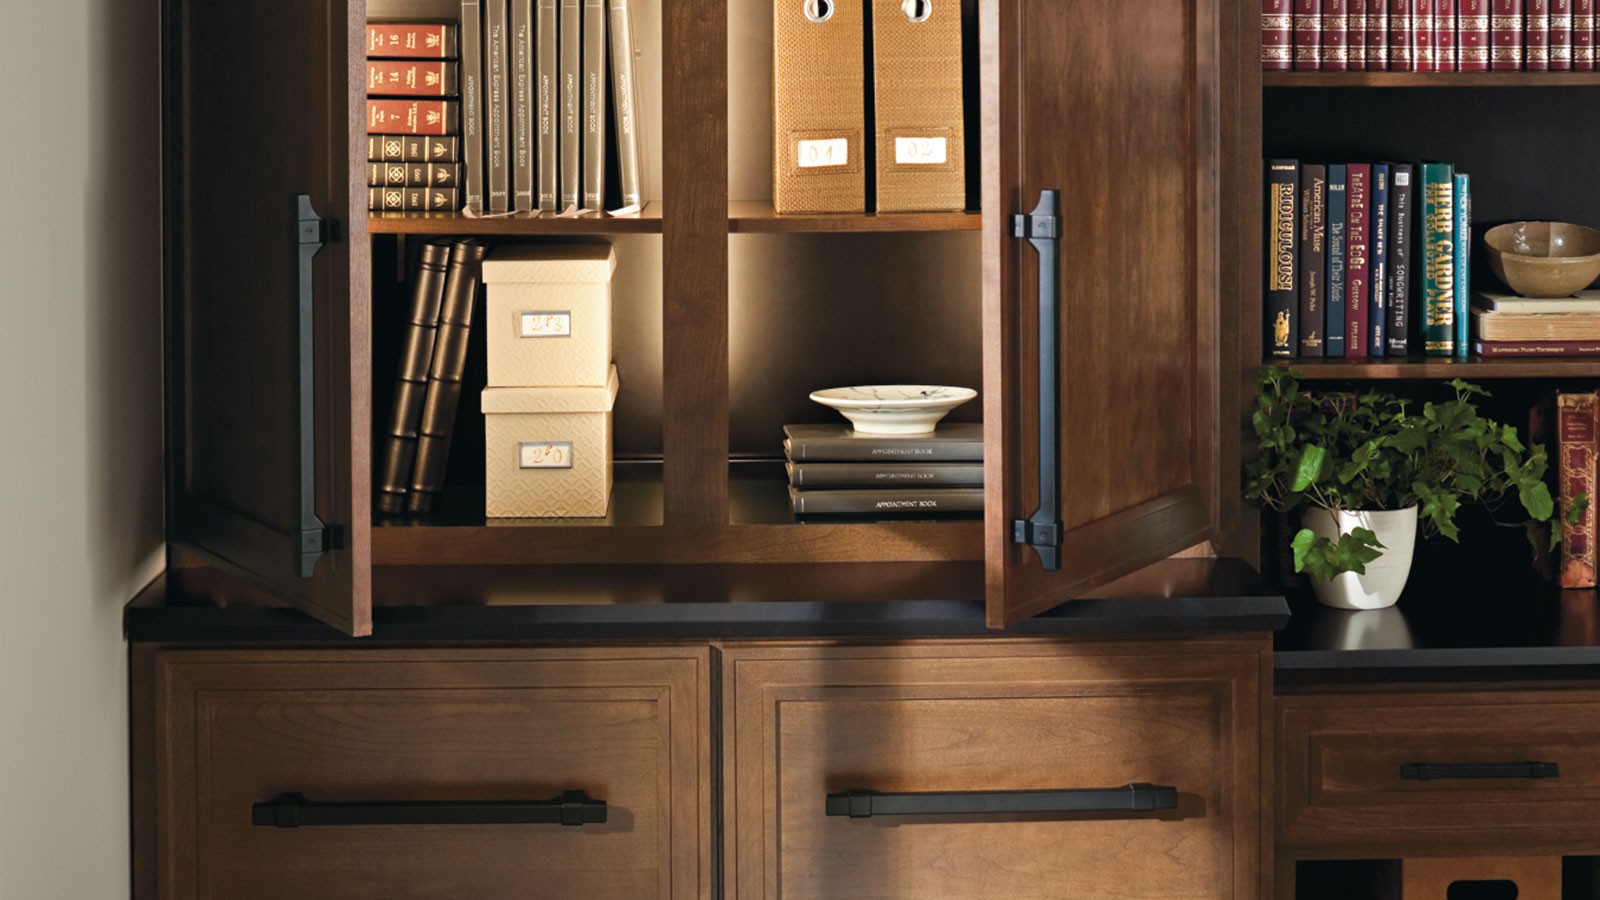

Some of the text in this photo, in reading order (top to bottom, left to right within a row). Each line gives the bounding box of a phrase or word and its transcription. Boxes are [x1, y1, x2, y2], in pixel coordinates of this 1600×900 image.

[390, 35, 399, 45] 16
[390, 72, 399, 82] 14
[493, 104, 501, 148] Appointment
[518, 104, 526, 148] Appointment
[809, 145, 833, 163] 01
[908, 141, 932, 157] 02
[1397, 193, 1405, 208] This
[1435, 182, 1453, 232] HERB
[1313, 177, 1324, 252] American Muse
[1279, 184, 1294, 291] RIDICULOUS!
[1332, 223, 1343, 234] The
[1397, 212, 1405, 245] Business
[1331, 236, 1343, 250] Sound
[1397, 249, 1404, 257] of
[1426, 182, 1434, 325] THE COLLECTED PLAYS
[1332, 251, 1343, 259] of
[1350, 245, 1365, 270] EDGE
[1331, 260, 1343, 281] Their
[1435, 240, 1453, 326] GARDNER
[1395, 264, 1405, 327] SONGWRITING
